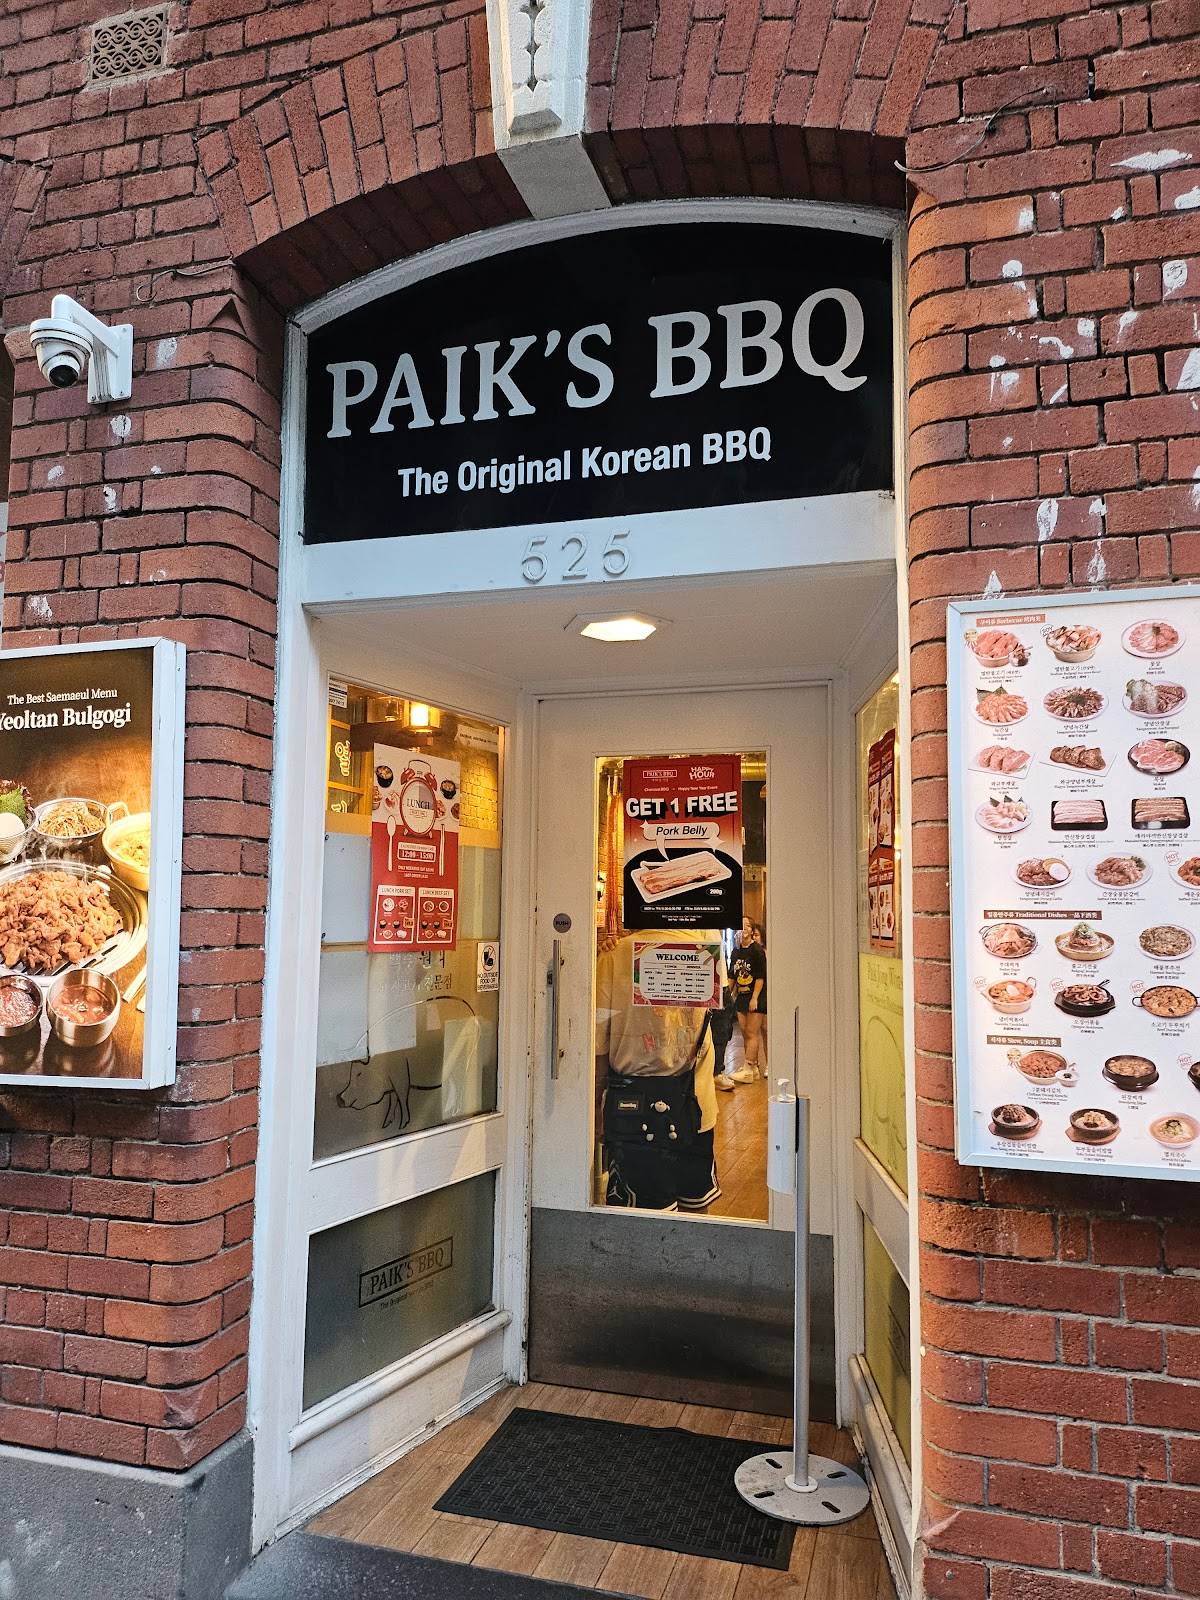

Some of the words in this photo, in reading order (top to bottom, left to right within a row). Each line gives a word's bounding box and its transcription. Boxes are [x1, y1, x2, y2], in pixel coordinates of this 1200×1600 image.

[325, 322, 615, 439] PAIK'S
[647, 287, 868, 399] BBQ
[398, 466, 448, 498] The
[457, 448, 571, 494] Original
[581, 440, 691, 480] Korean
[702, 426, 772, 465] BBQ
[519, 528, 632, 584] 525
[7, 694, 24, 706] The
[26, 692, 45, 704] Best
[46, 688, 90, 702] Saemaeul
[91, 688, 118, 700] Menu
[62, 702, 132, 730] Bulgogi
[688, 770, 715, 780] HOUR
[406, 798, 430, 810] LUNCH
[626, 797, 664, 818] GET
[670, 797, 680, 814] 1
[687, 790, 738, 813] FREE
[656, 826, 680, 836] Pork
[682, 825, 708, 836] Belly
[656, 953, 700, 962] WELCOME
[368, 1260, 414, 1296] PAIK'S
[417, 1248, 444, 1274] BBQ
